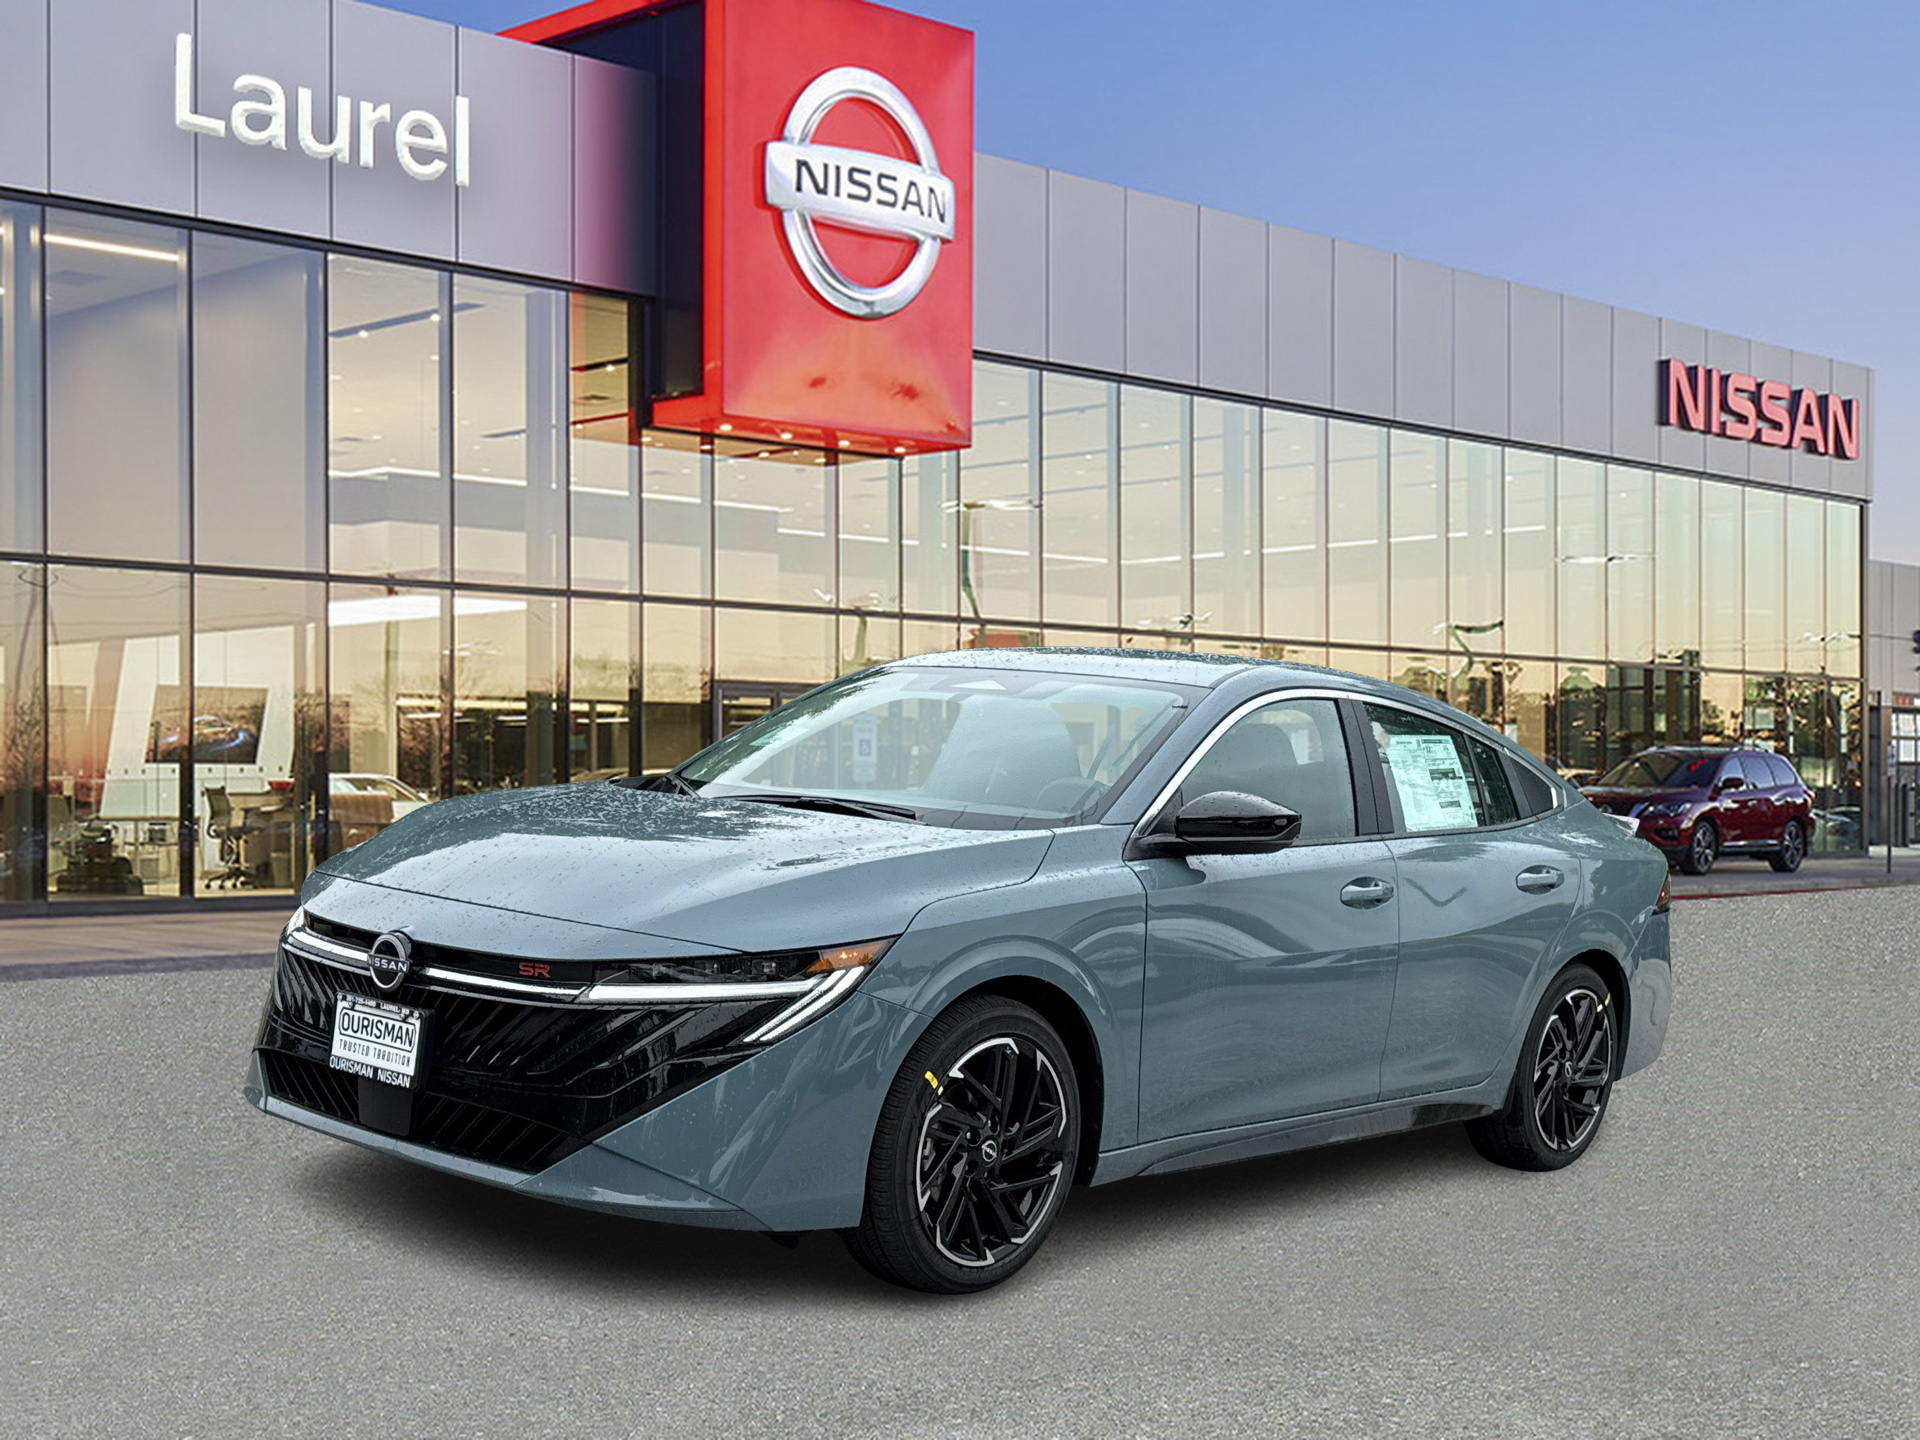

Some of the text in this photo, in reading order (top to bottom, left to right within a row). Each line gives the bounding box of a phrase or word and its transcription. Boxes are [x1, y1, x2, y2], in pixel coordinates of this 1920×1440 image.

[175, 32, 470, 187] Laurel
[795, 159, 947, 223] NISSAN
[1658, 358, 1859, 460] NISSAN
[367, 954, 407, 972] NISSAN
[518, 961, 551, 978] SR
[341, 1012, 415, 1048] OURISMAN
[339, 1038, 411, 1068] TRUSTED TRADITION
[329, 1055, 411, 1089] OURISMAN NISSAN
